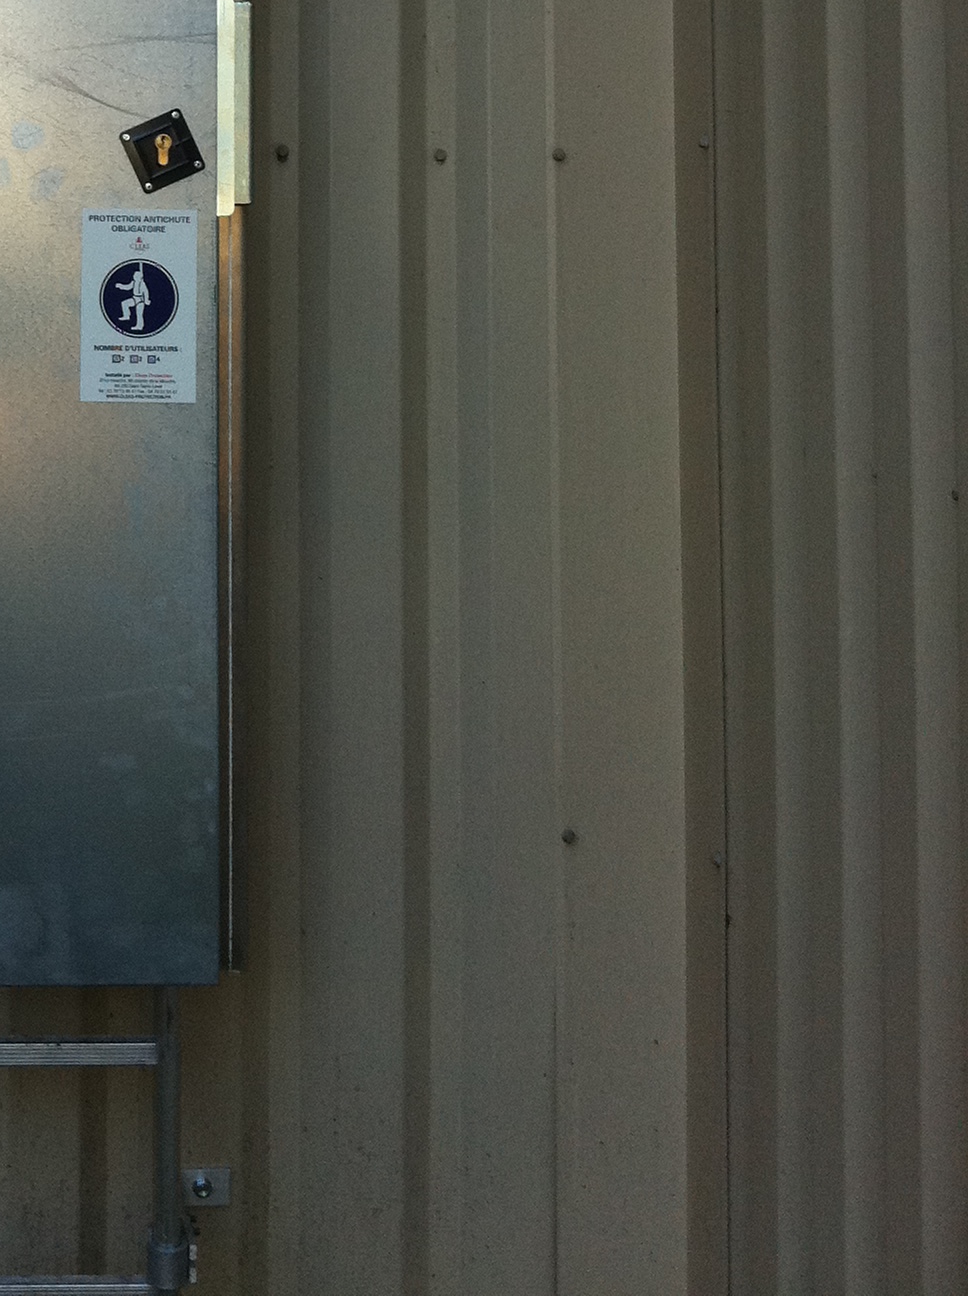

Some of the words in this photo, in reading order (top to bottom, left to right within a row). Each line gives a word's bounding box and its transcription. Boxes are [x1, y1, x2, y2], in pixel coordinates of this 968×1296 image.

[88, 214, 141, 223] PROTECTION
[143, 215, 191, 224] ANTICHUTE
[111, 225, 166, 233] OBLIGATOIRE
